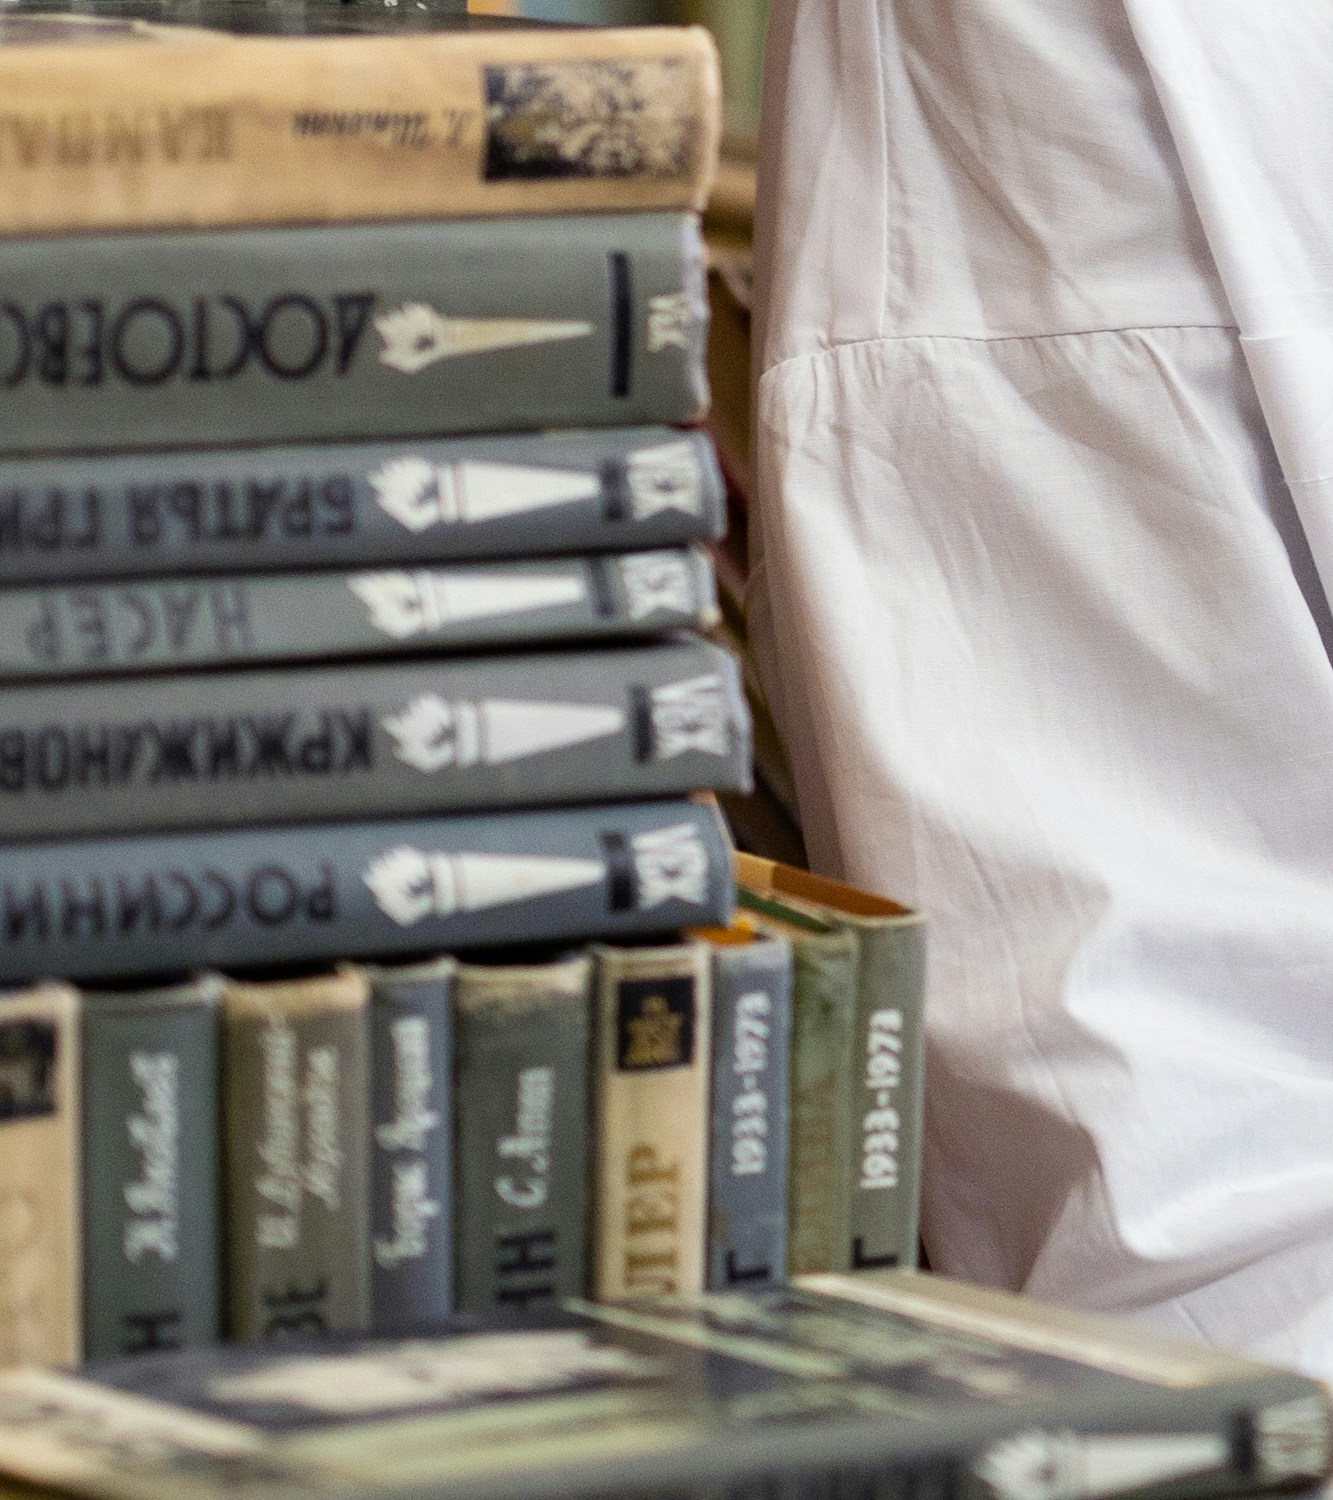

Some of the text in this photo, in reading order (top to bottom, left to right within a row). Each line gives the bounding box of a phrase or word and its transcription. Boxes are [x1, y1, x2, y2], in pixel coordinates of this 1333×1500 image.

[124, 474, 355, 549] БРАТЬЯ
[24, 584, 256, 666] НАСЕР
[729, 990, 772, 1178] 1933-1973
[860, 1008, 903, 1192] 1933-1973
